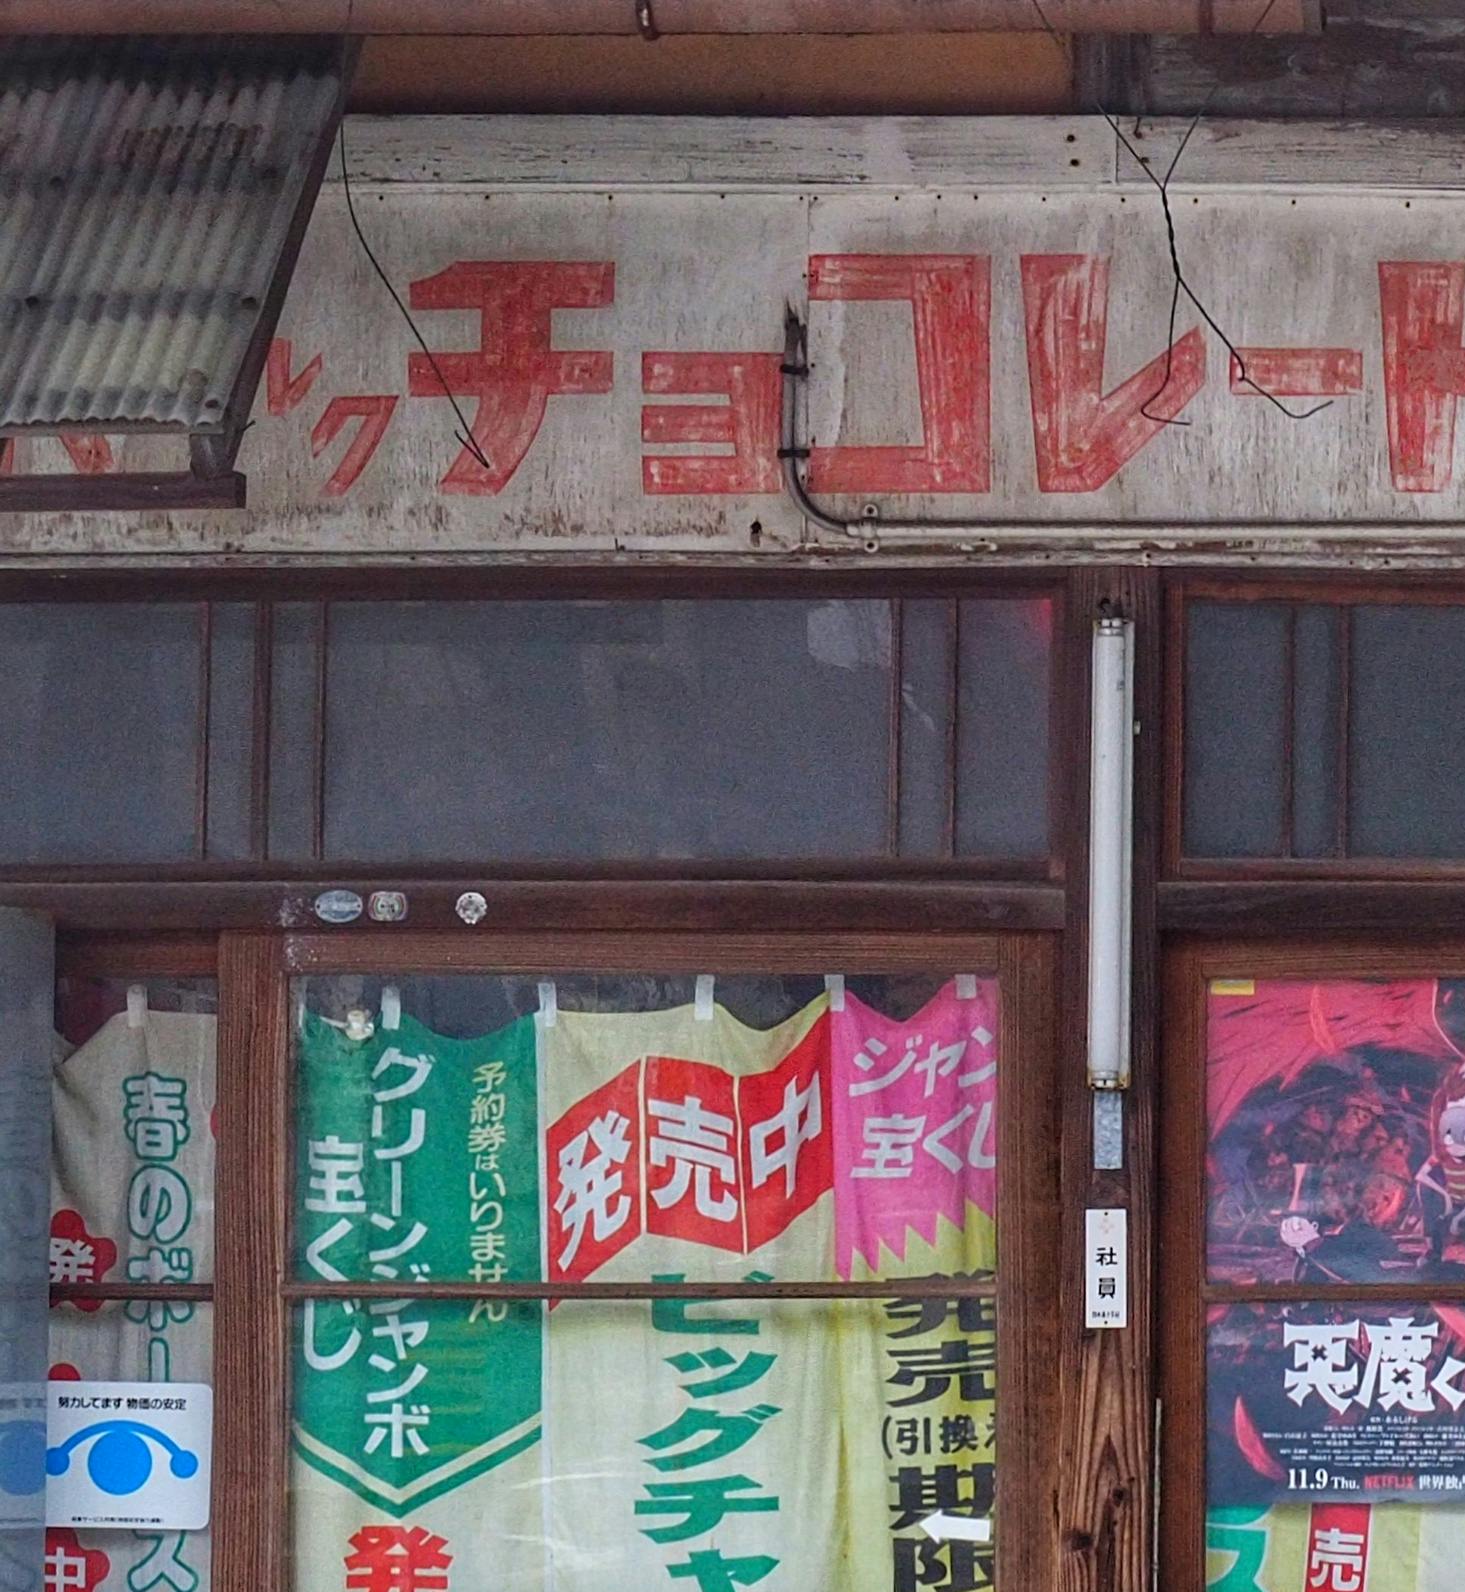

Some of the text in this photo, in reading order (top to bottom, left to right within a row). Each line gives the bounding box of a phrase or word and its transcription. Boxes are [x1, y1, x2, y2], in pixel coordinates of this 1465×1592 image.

[303, 1135, 367, 1372] 宝くじ
[553, 1072, 822, 1272] 発売中
[1287, 1468, 1329, 1490] 11.9
